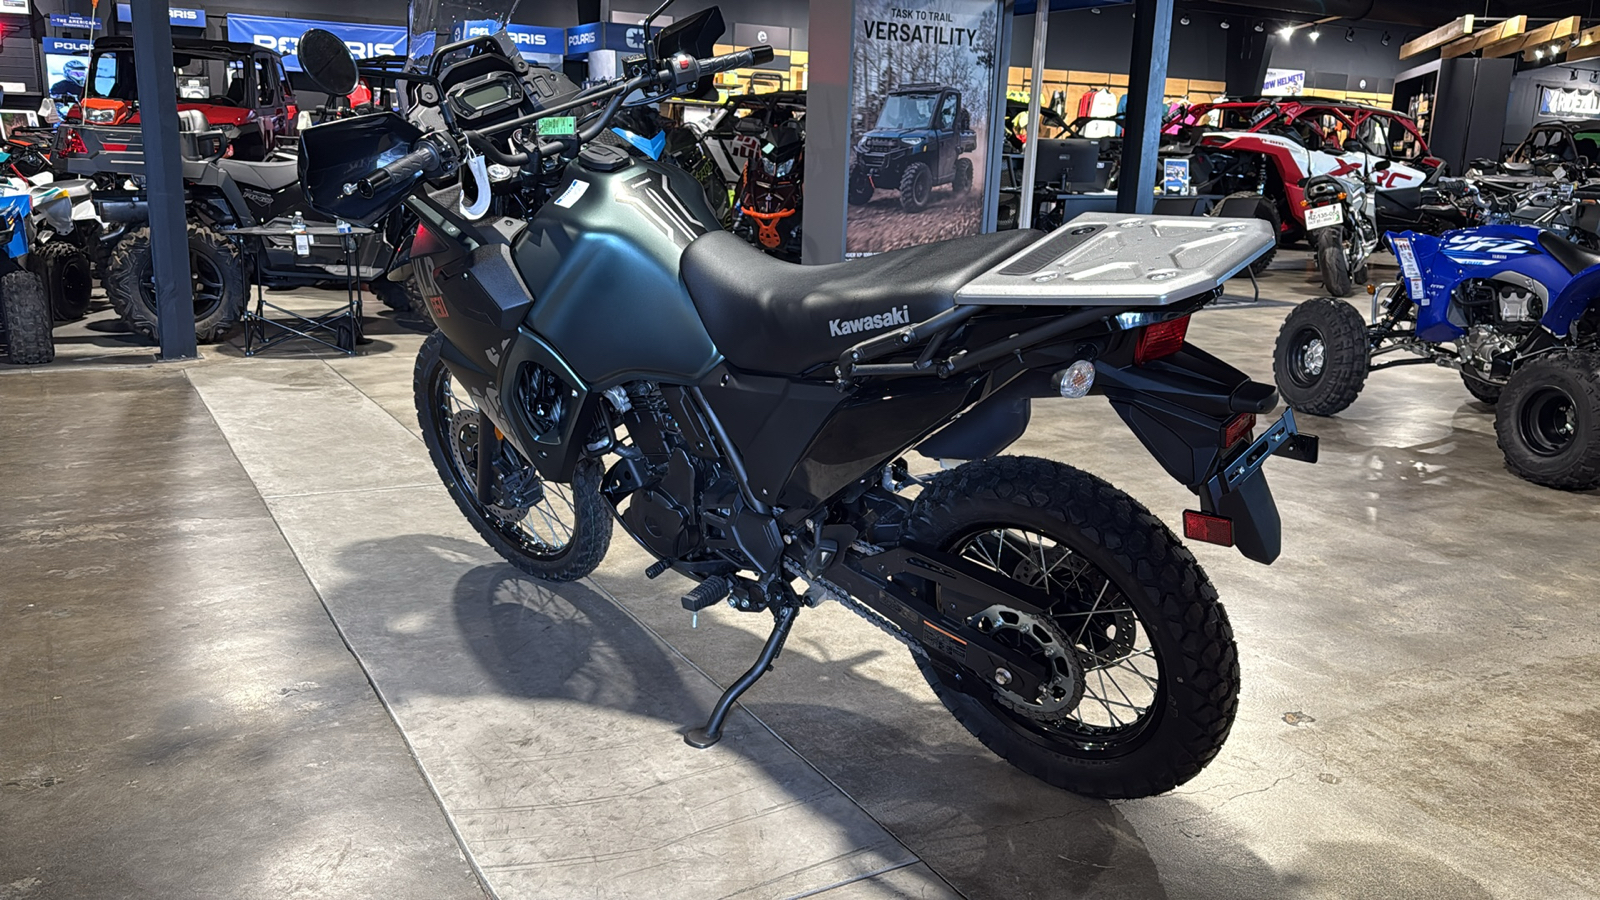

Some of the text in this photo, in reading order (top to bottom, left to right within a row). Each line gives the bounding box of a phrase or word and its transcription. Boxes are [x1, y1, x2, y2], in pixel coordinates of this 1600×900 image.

[891, 8, 953, 22] TASK TO TRAIL
[568, 32, 596, 47] POLARIS
[863, 19, 978, 47] VERSATILITY
[1277, 72, 1304, 87] HELMETS
[828, 304, 910, 337] Kawasaki
